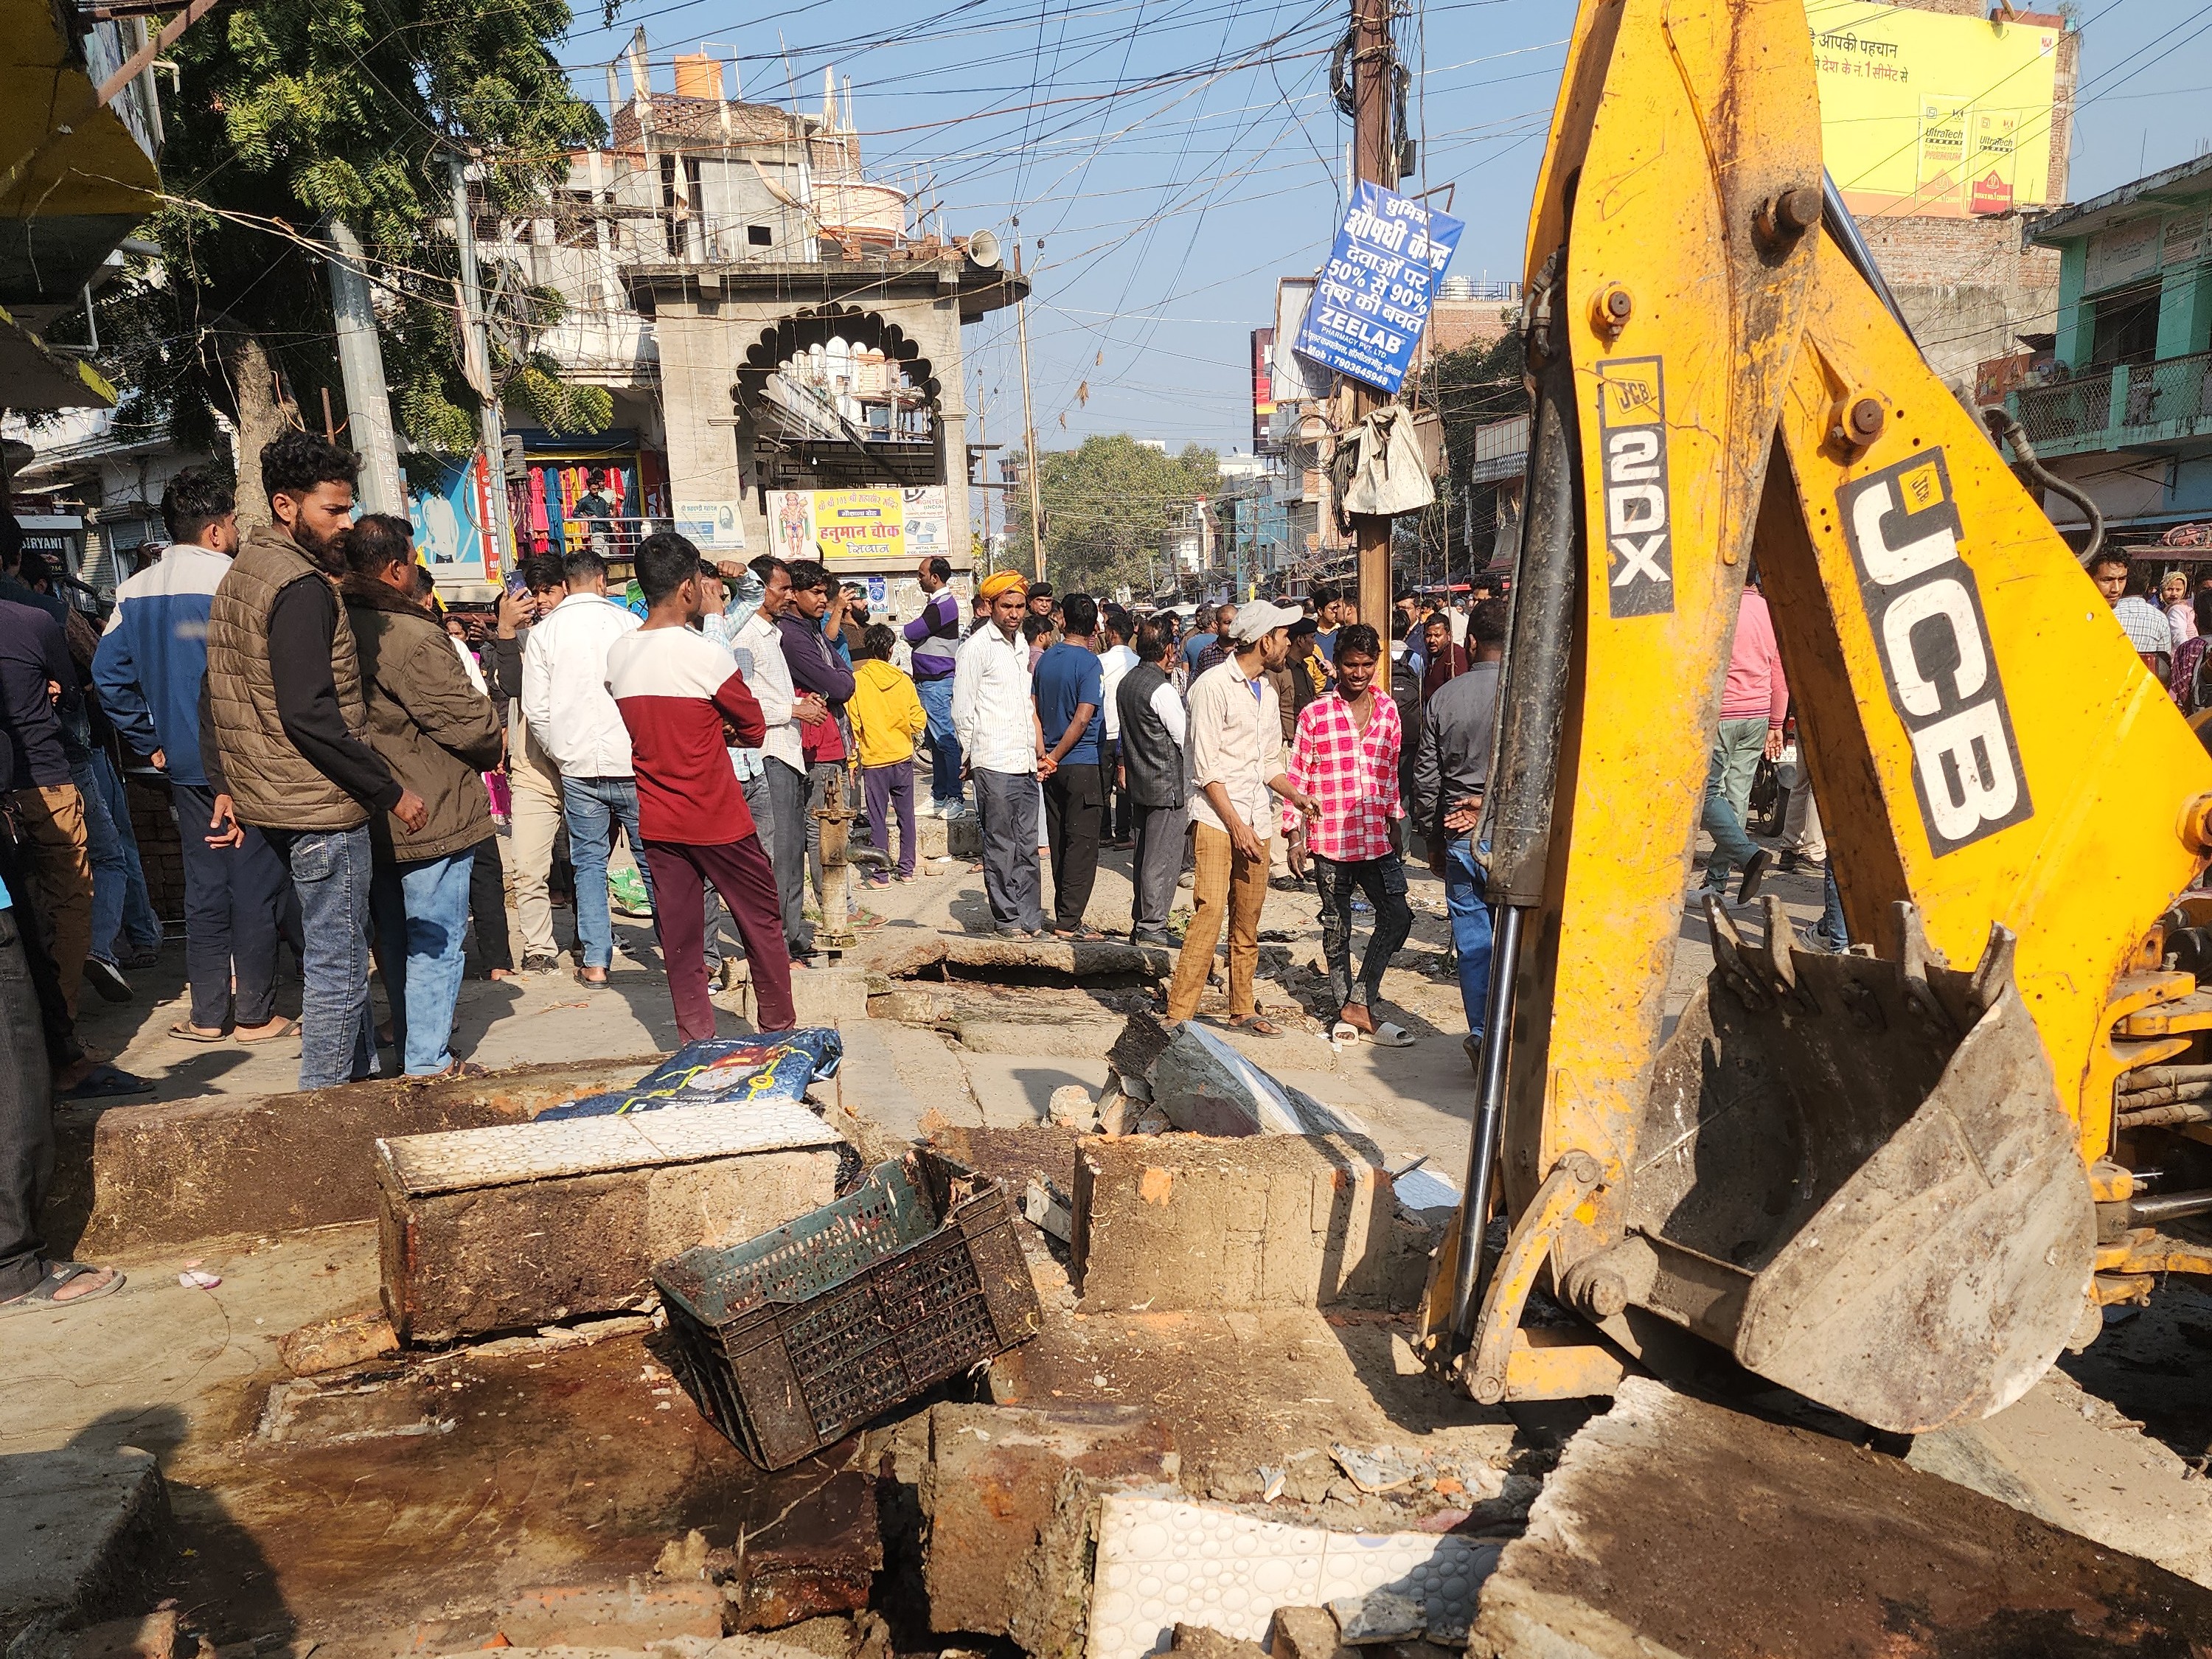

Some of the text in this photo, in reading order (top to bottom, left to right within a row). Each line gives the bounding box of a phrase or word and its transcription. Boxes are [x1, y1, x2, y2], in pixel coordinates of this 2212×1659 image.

[1819, 32, 1857, 52] आपकी
[1860, 40, 1898, 58] पहचान
[1822, 55, 1838, 73] देश
[1842, 58, 1851, 74] के
[1873, 63, 1898, 81] सीमेंट
[1900, 67, 1909, 83] से
[1926, 128, 1963, 139] UltraTech
[1979, 136, 2013, 147] UltraTech
[1346, 245, 1430, 291] दवाओं पर
[1328, 259, 1428, 316] 50% से 90%
[1320, 279, 1424, 334] तक की बचत
[1317, 307, 1403, 354] ZEELAB
[1321, 326, 1387, 359] PHARMACY PVT. LTD.
[1334, 356, 1388, 386] 7903645948
[1619, 380, 1649, 409] JCB
[1911, 472, 1930, 503] JCB
[1609, 431, 1671, 587] 2DX
[818, 521, 900, 543] हनुमान चौक
[846, 542, 890, 554] सिवान
[1853, 481, 2018, 841] JCB
